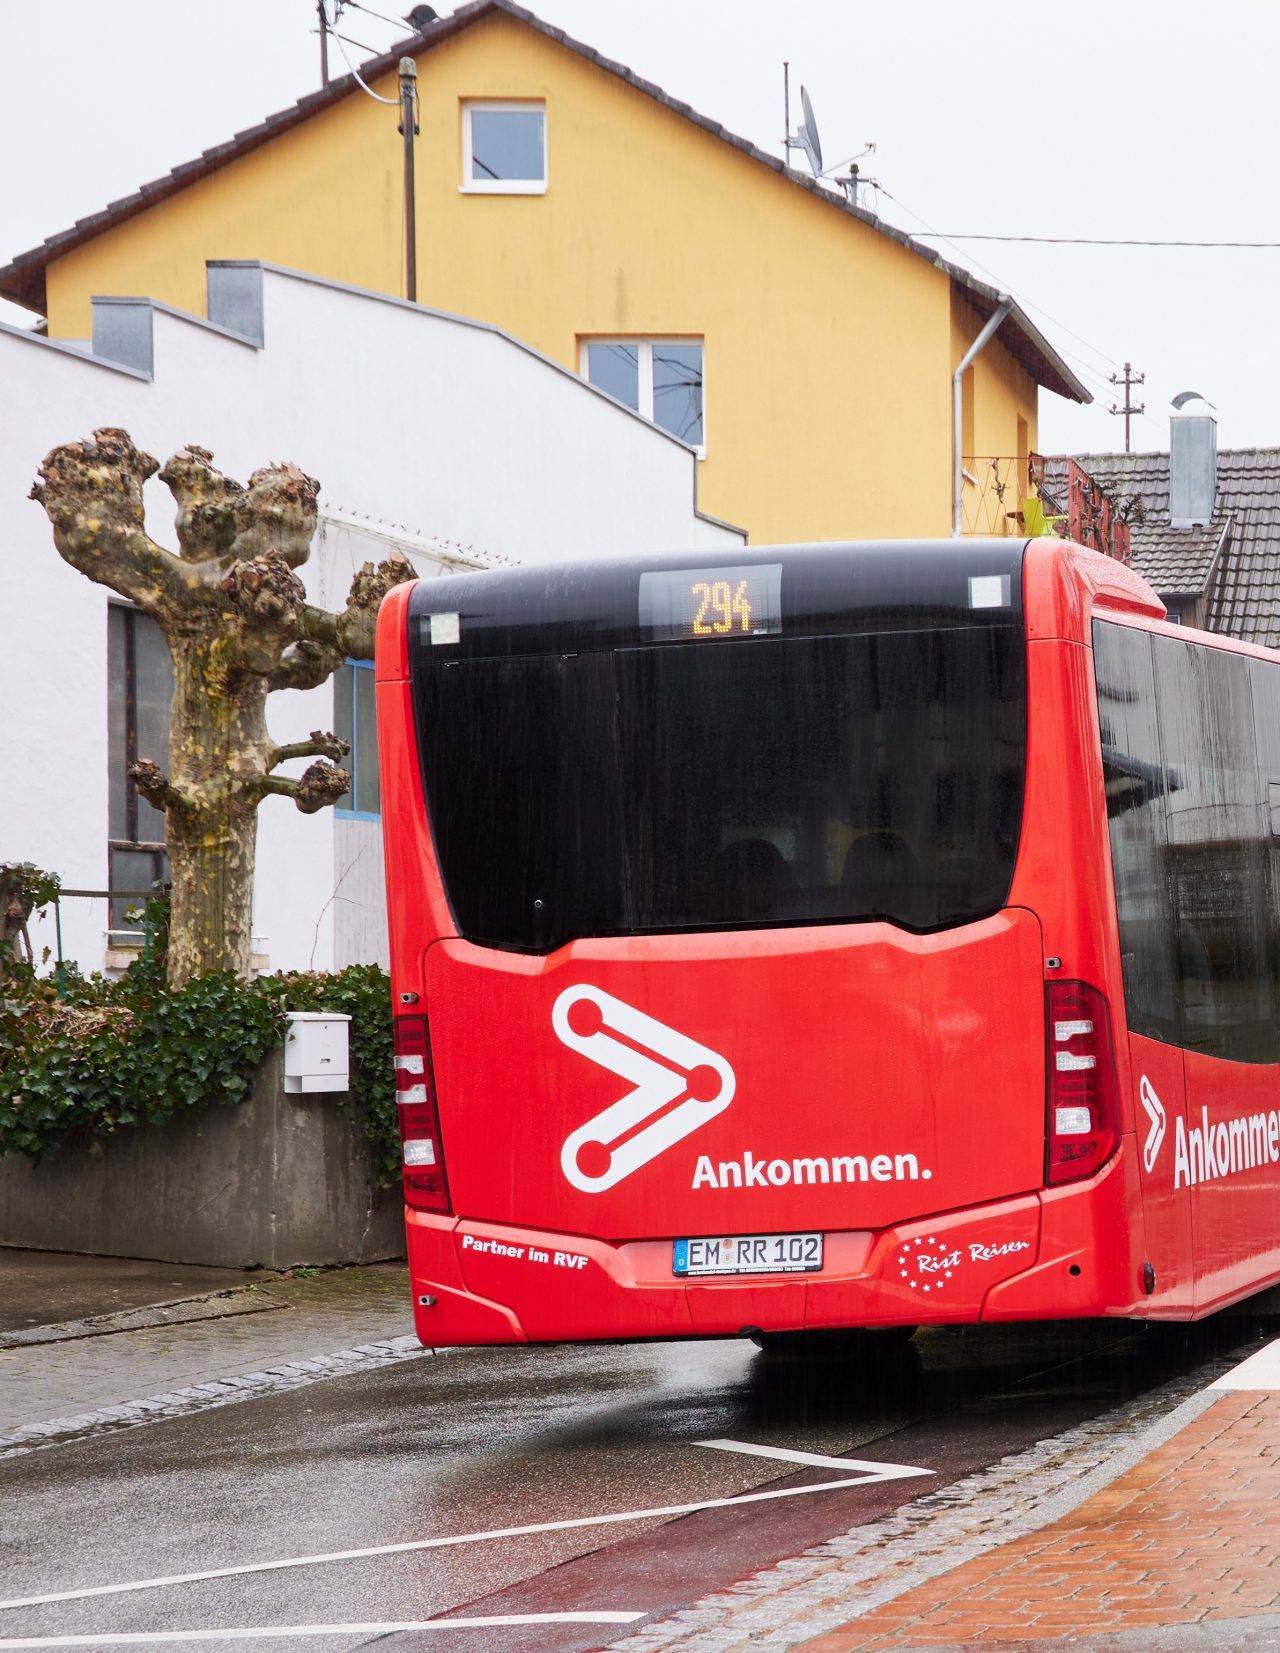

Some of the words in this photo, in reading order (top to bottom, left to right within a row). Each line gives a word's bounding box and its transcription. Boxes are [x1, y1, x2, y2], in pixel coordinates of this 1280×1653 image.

[692, 580, 750, 634] 294
[691, 1151, 933, 1189] Ankommen.
[462, 1235, 525, 1259] Partner
[528, 1247, 549, 1264] im
[553, 1252, 589, 1270] RVF
[689, 1241, 720, 1266] EM
[737, 1239, 767, 1264] RR
[773, 1238, 818, 1263] 102
[916, 1250, 962, 1273] Rist
[968, 1239, 1030, 1262] Reisen
